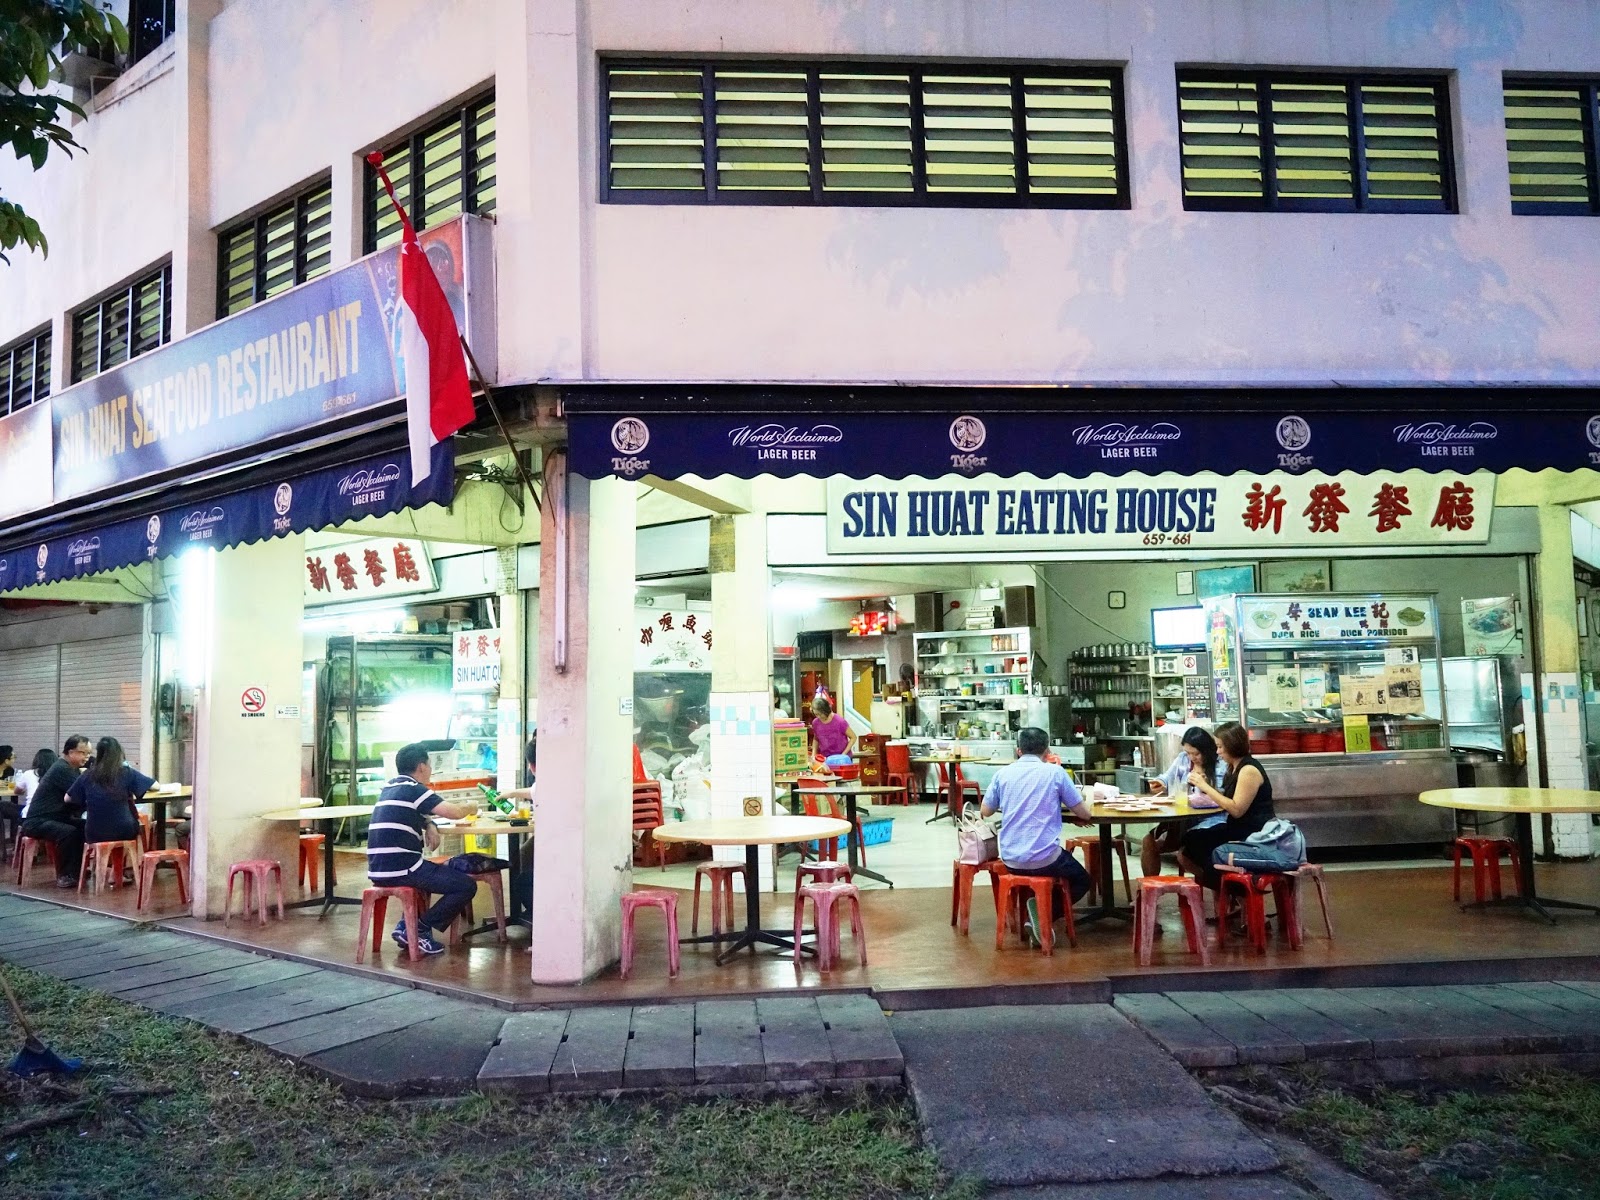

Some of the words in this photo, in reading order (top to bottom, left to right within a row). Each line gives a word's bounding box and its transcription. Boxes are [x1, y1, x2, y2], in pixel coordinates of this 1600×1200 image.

[60, 411, 85, 473] SIN
[88, 394, 128, 461] HUAT
[132, 358, 212, 450] SEAFOOD
[217, 300, 362, 419] RESTAURANT
[728, 424, 784, 446] World
[776, 424, 843, 447] Acclaimed
[1072, 423, 1123, 445] World
[1115, 423, 1181, 445] Acclaimed
[1393, 422, 1440, 443] World
[1432, 422, 1498, 443] Acclaimed
[758, 449, 788, 460] LAGER
[792, 449, 816, 460] BEER
[1101, 447, 1130, 458] LAGER
[1133, 447, 1158, 458] BEER
[1421, 446, 1448, 456] LAGER
[1451, 446, 1475, 456] BEER
[611, 457, 650, 476] Tiger
[950, 454, 987, 471] Tiger
[1277, 453, 1313, 470] Tiger
[337, 470, 368, 496] World
[361, 463, 401, 489] Acclaimed
[352, 493, 369, 506] LAGER
[369, 490, 385, 503] BEER
[843, 489, 898, 538] SIN
[907, 490, 990, 537] HUAT
[996, 488, 1110, 536] EATING
[1114, 487, 1217, 534] HOUSE
[1242, 481, 1475, 535] 新發餐廳
[273, 517, 291, 533] Tiger
[189, 531, 202, 541] LAGER
[202, 528, 213, 539] BEER
[1142, 532, 1191, 545] 659-661
[306, 542, 420, 593] 新發餐廳
[1307, 606, 1339, 619] SEAN
[1344, 606, 1368, 618] KEE
[1271, 631, 1295, 639] DUCK
[1300, 630, 1320, 638] RICE
[1340, 629, 1363, 638] DUCK
[1366, 628, 1408, 637] PORRIDGE
[457, 666, 469, 682] SIN
[470, 665, 491, 681] HUAT
[1355, 733, 1364, 745] B
